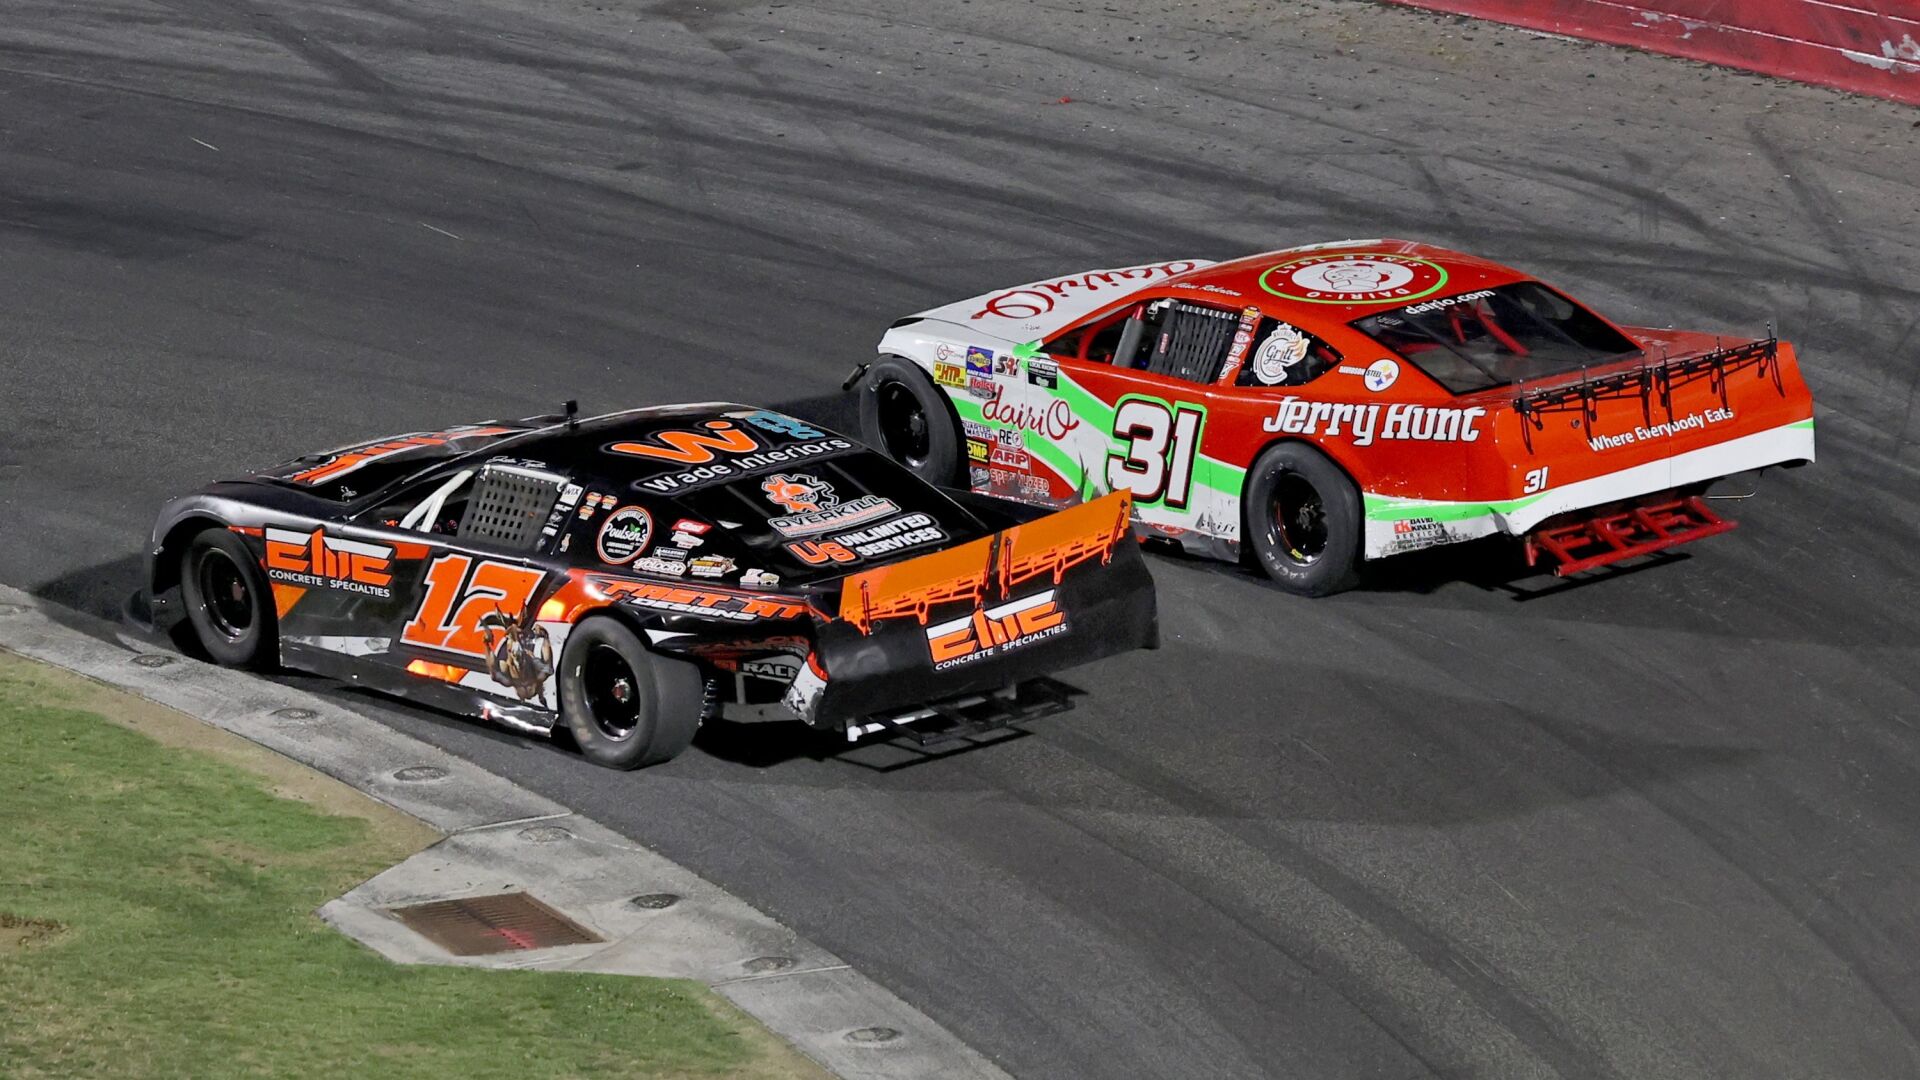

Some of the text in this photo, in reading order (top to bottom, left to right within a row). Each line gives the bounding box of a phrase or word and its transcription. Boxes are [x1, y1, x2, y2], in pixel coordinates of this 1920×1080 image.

[1305, 287, 1411, 300] DAIRI-O
[1264, 345, 1294, 365] Grill
[1366, 370, 1382, 378] STEEL
[1263, 396, 1486, 446] Jerry Hunt
[1587, 406, 1734, 452] Where Everybody Eats
[643, 439, 852, 492] Wade Interiors
[994, 450, 1027, 465] ARP
[1105, 398, 1204, 511] 31
[565, 487, 579, 496] WIX
[1523, 466, 1549, 493] 31
[774, 496, 885, 528] OVERKILL
[1410, 517, 1434, 525] DAVID
[834, 514, 932, 547] UNLIMITED
[855, 527, 943, 556] SERVICES
[269, 569, 390, 598] CONCRETE SPECIALTIES
[400, 553, 547, 659] 12
[631, 598, 758, 620] DESIGNS
[935, 623, 1067, 671] CONCRETE SPECIALTIES
